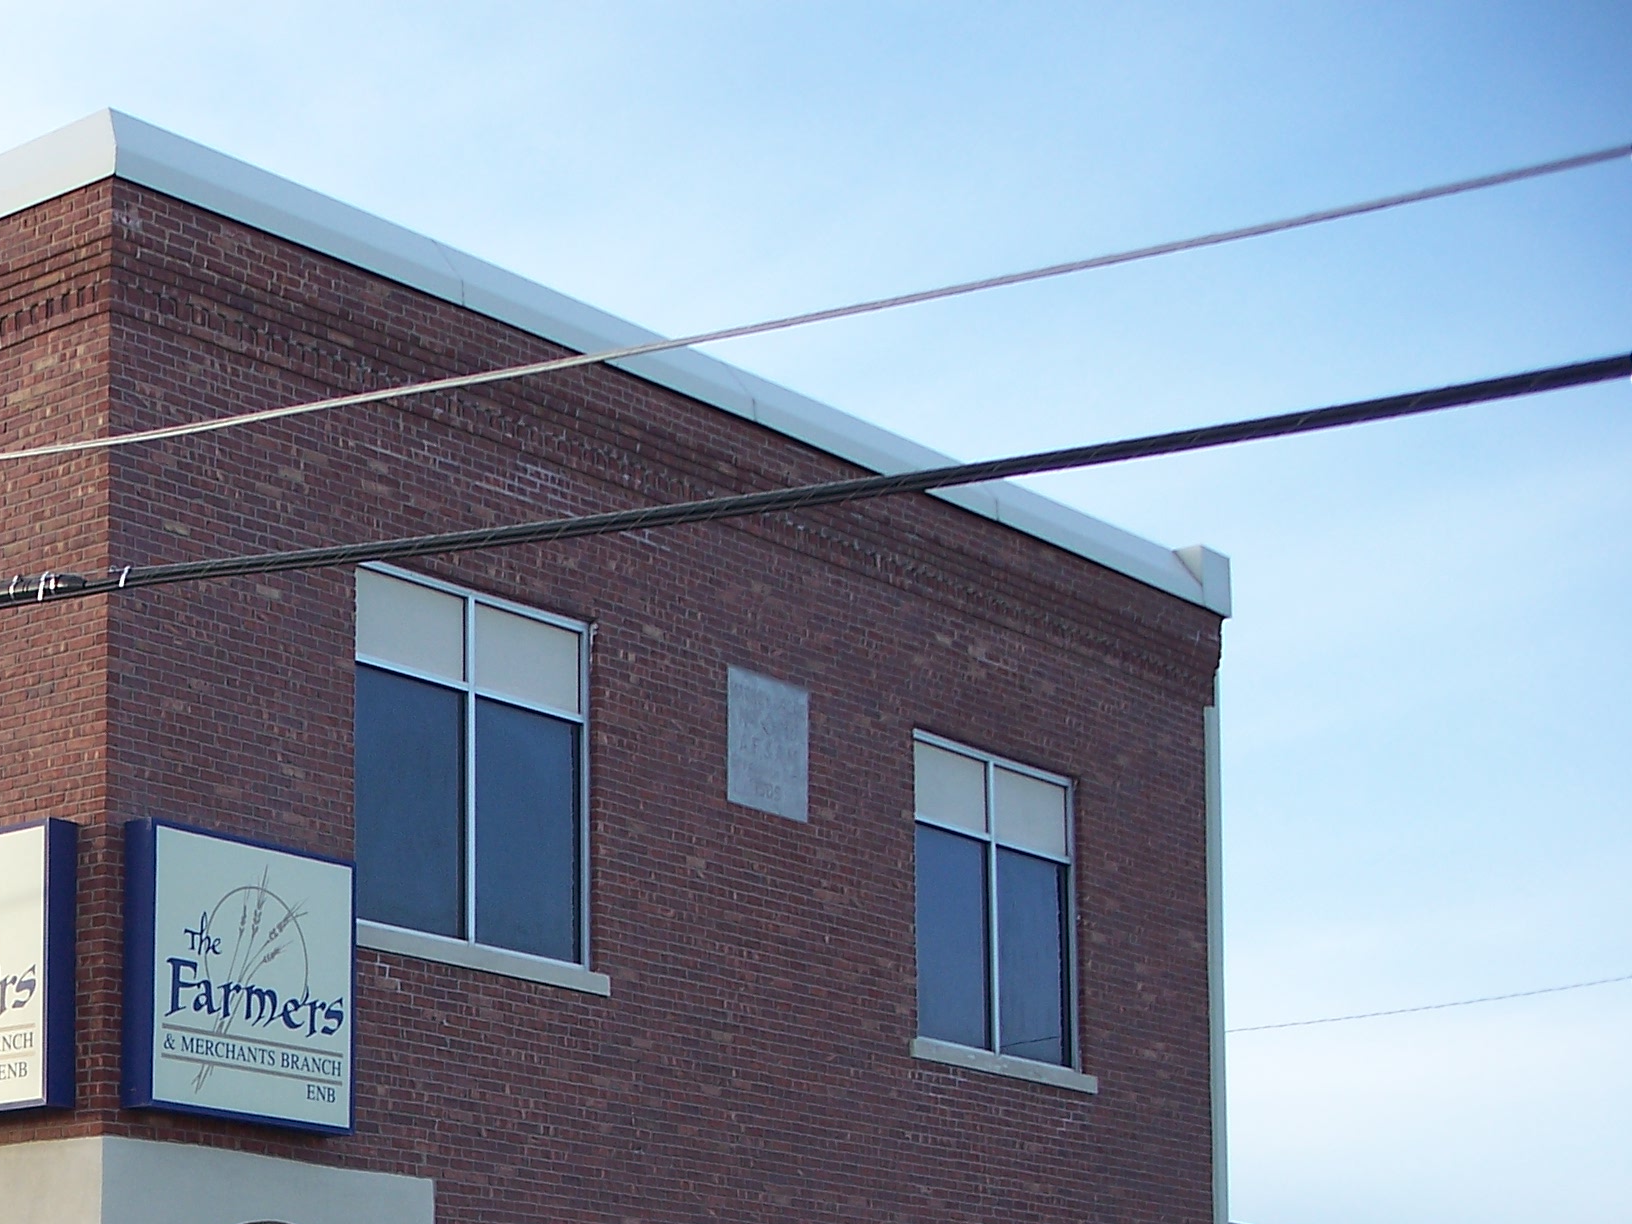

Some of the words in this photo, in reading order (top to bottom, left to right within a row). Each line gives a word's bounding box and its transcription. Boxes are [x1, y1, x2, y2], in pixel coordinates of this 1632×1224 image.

[184, 911, 222, 956] The
[163, 956, 345, 1038] Farmers
[163, 1033, 176, 1051] &
[180, 1036, 278, 1067] MERCHANTS
[280, 1051, 343, 1078] BRANCH
[306, 1083, 337, 1104] ENB
